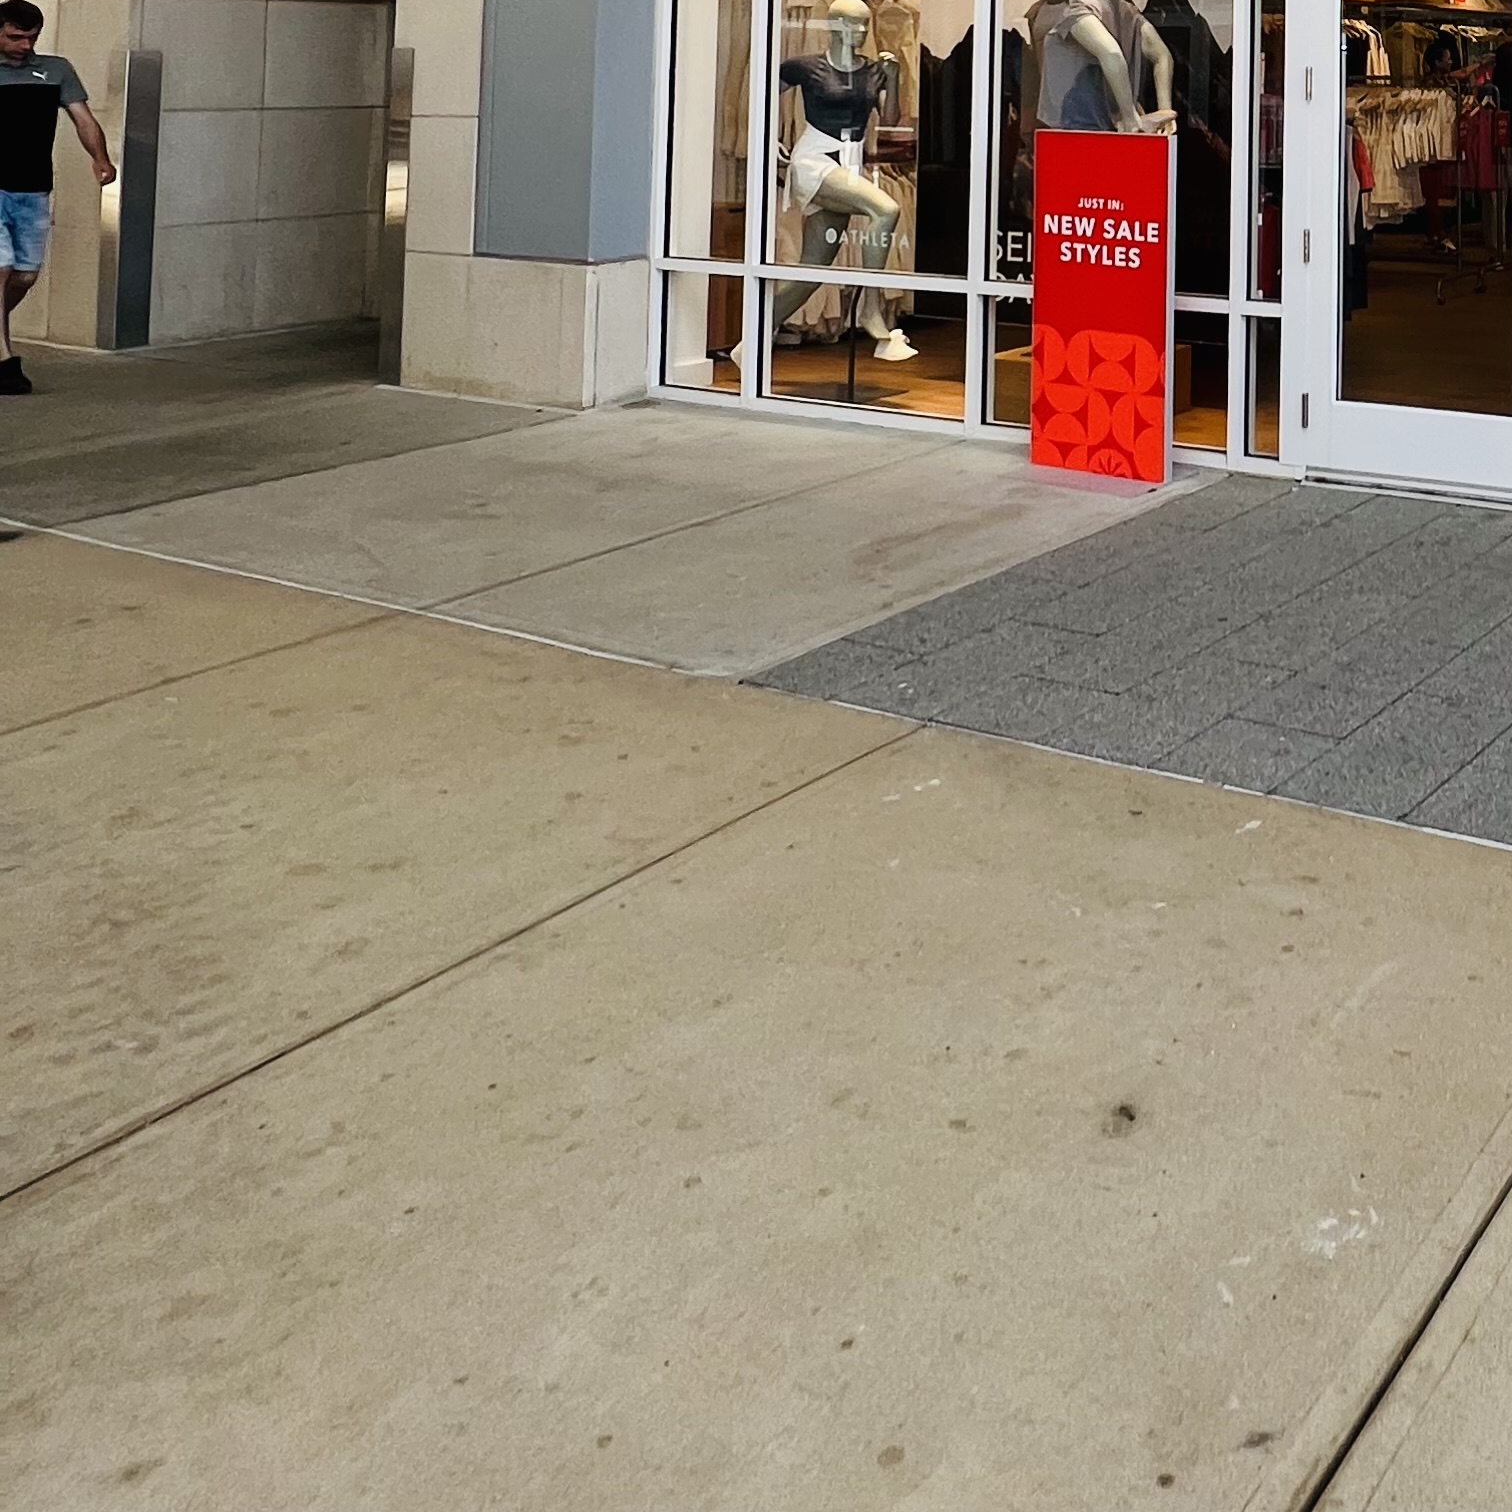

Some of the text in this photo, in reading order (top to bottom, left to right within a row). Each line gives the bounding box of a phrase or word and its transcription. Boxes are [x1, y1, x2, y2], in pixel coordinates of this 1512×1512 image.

[1078, 197, 1124, 211] JUST IN:
[838, 229, 910, 249] ATHLETA
[1044, 214, 1159, 243] NEW SALE
[1060, 241, 1141, 268] STYLES
